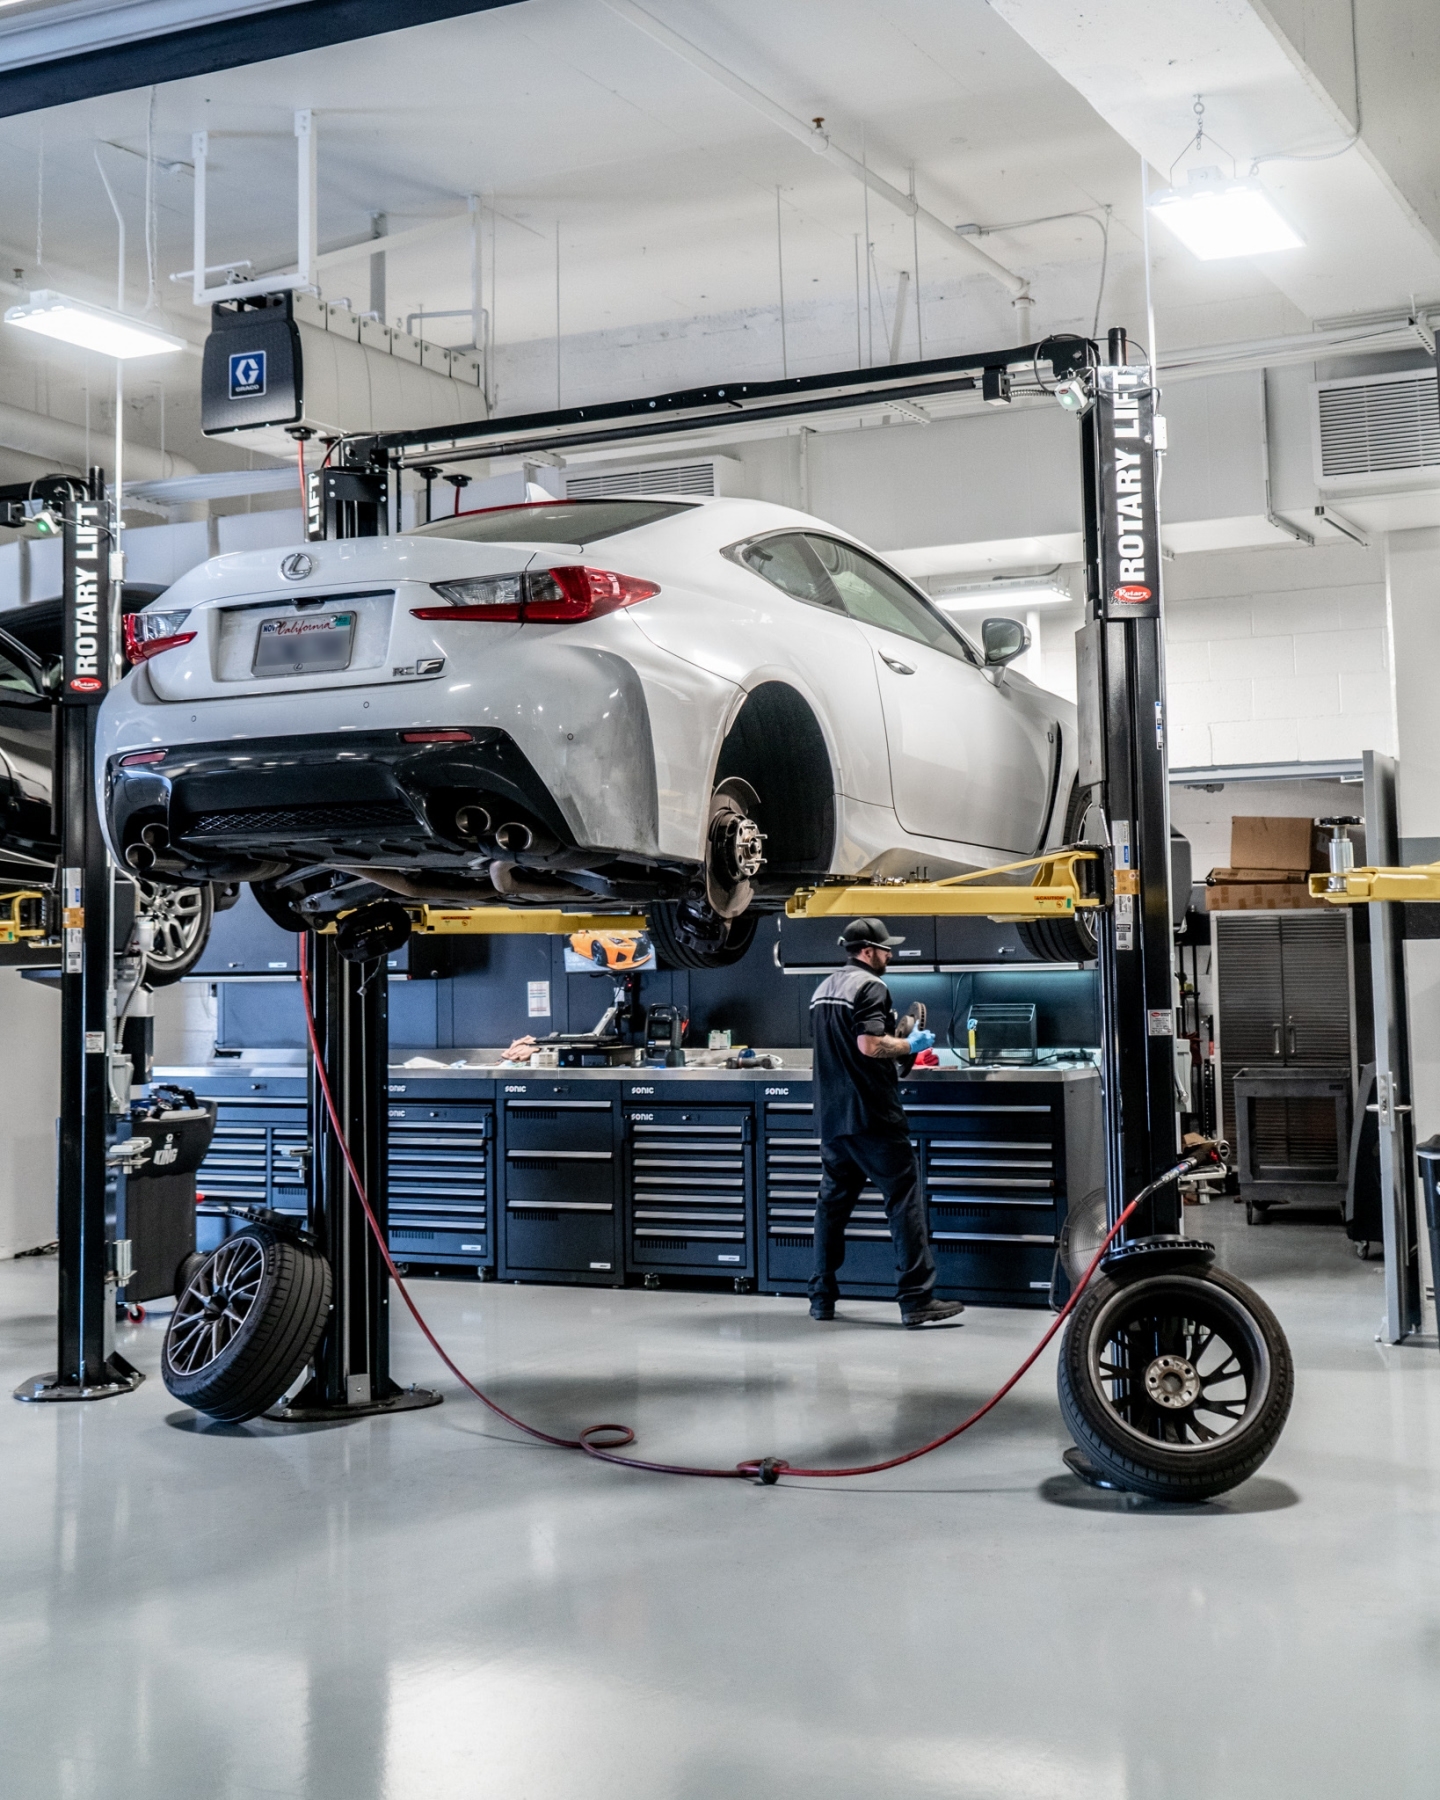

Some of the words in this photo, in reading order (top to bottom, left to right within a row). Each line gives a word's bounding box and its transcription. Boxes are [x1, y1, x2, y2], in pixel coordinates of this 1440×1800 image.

[235, 384, 260, 392] GRACO
[1112, 369, 1140, 438] LIFT
[308, 473, 320, 533] LIFT
[1115, 448, 1145, 581] ROTARY
[75, 502, 98, 559] LIFT
[1117, 588, 1147, 599] Rotary
[75, 566, 98, 675] ROTARY
[277, 620, 337, 635] California
[392, 666, 415, 676] RC
[388, 1084, 407, 1092] ONIC
[387, 1110, 406, 1118] ONIC
[153, 1148, 178, 1165] KING
